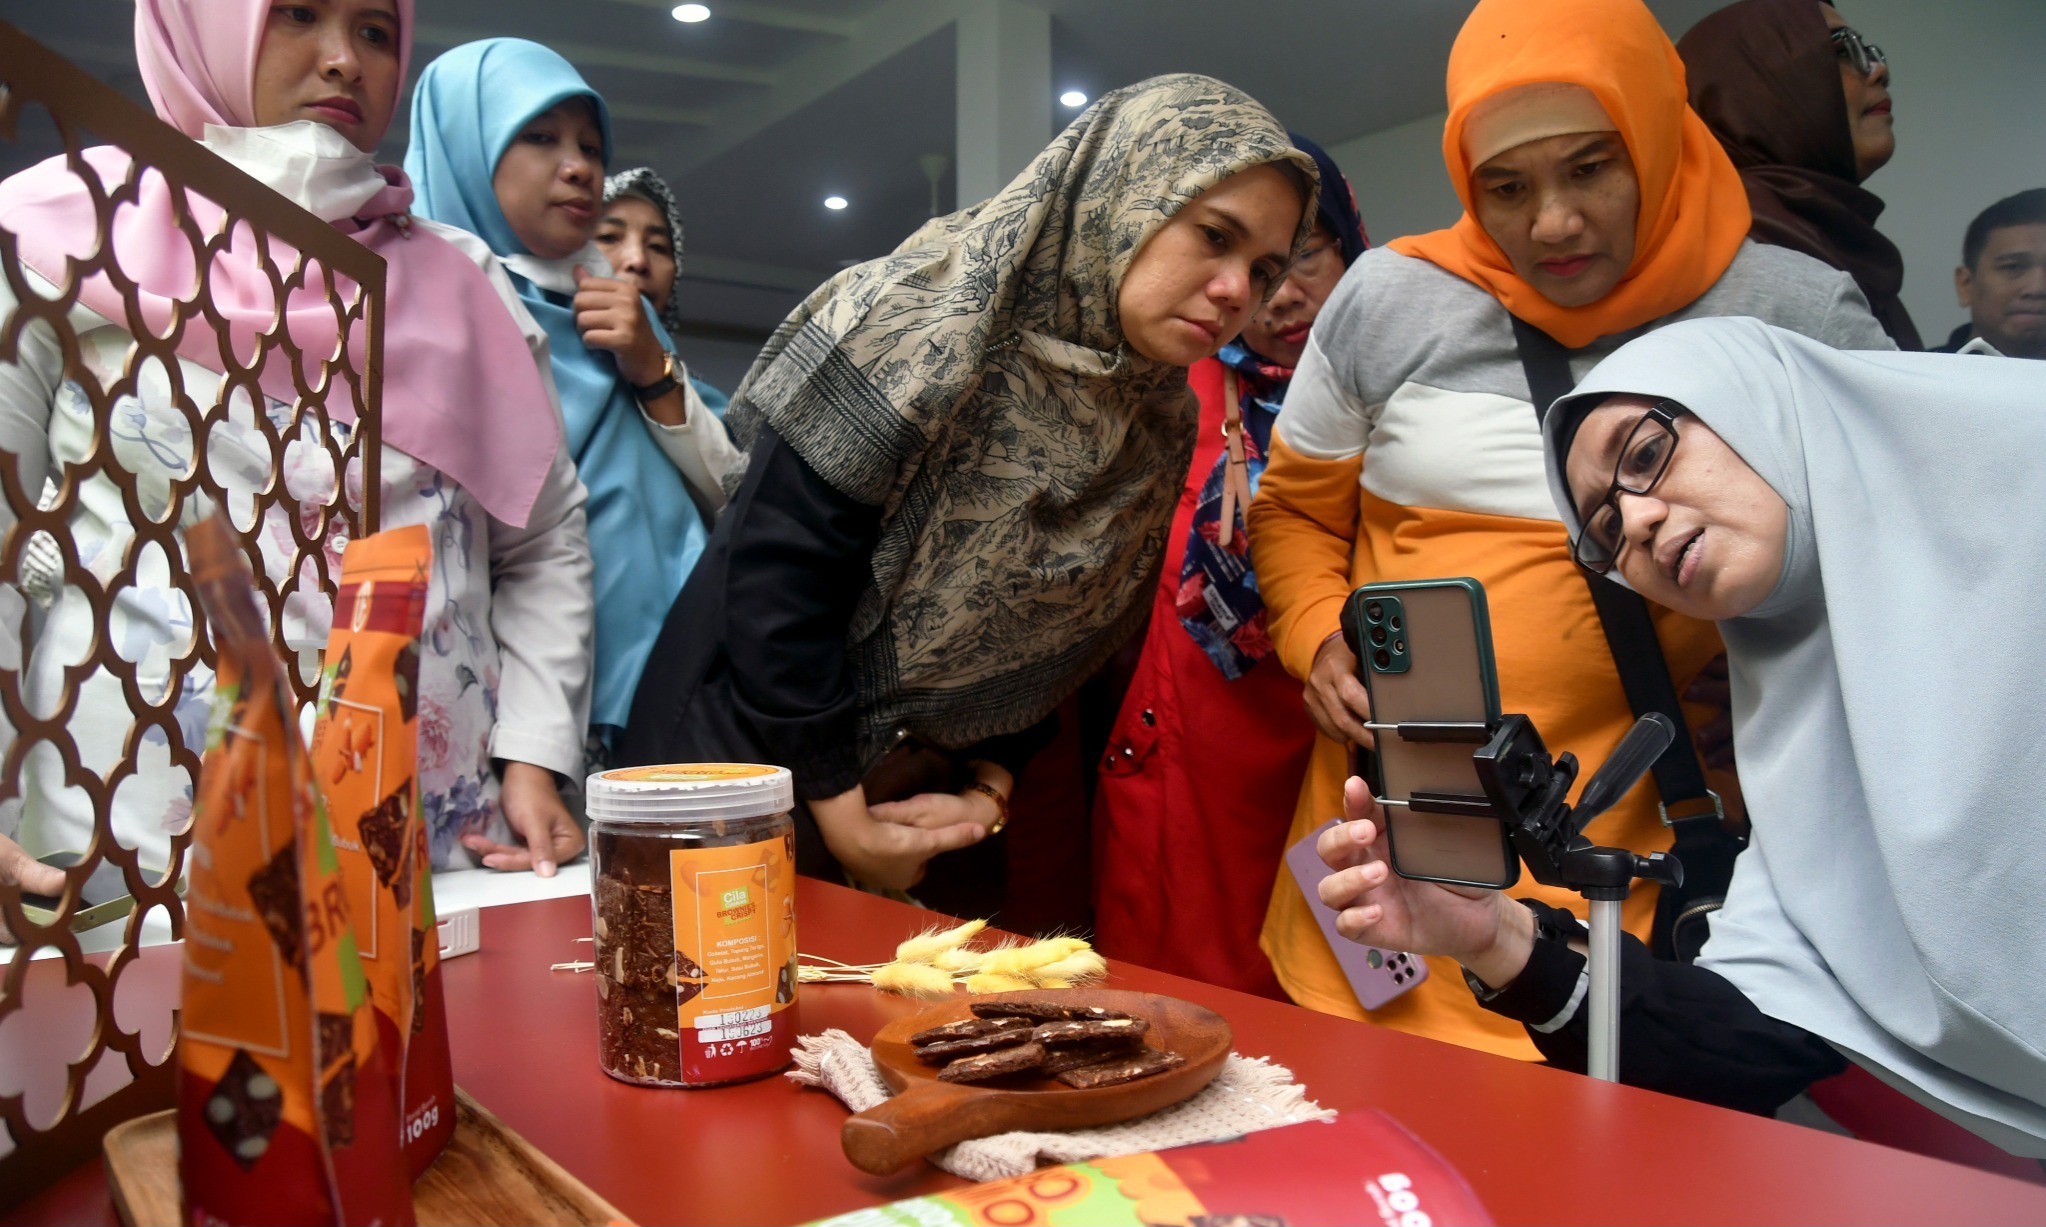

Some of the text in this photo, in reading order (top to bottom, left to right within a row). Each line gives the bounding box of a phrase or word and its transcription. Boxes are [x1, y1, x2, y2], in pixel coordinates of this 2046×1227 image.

[723, 890, 746, 903] Cila
[716, 902, 756, 918] BROWNIES
[730, 908, 756, 921] CRISPY
[716, 935, 757, 948] KOMPOSISI
[406, 1104, 438, 1143] 100g
